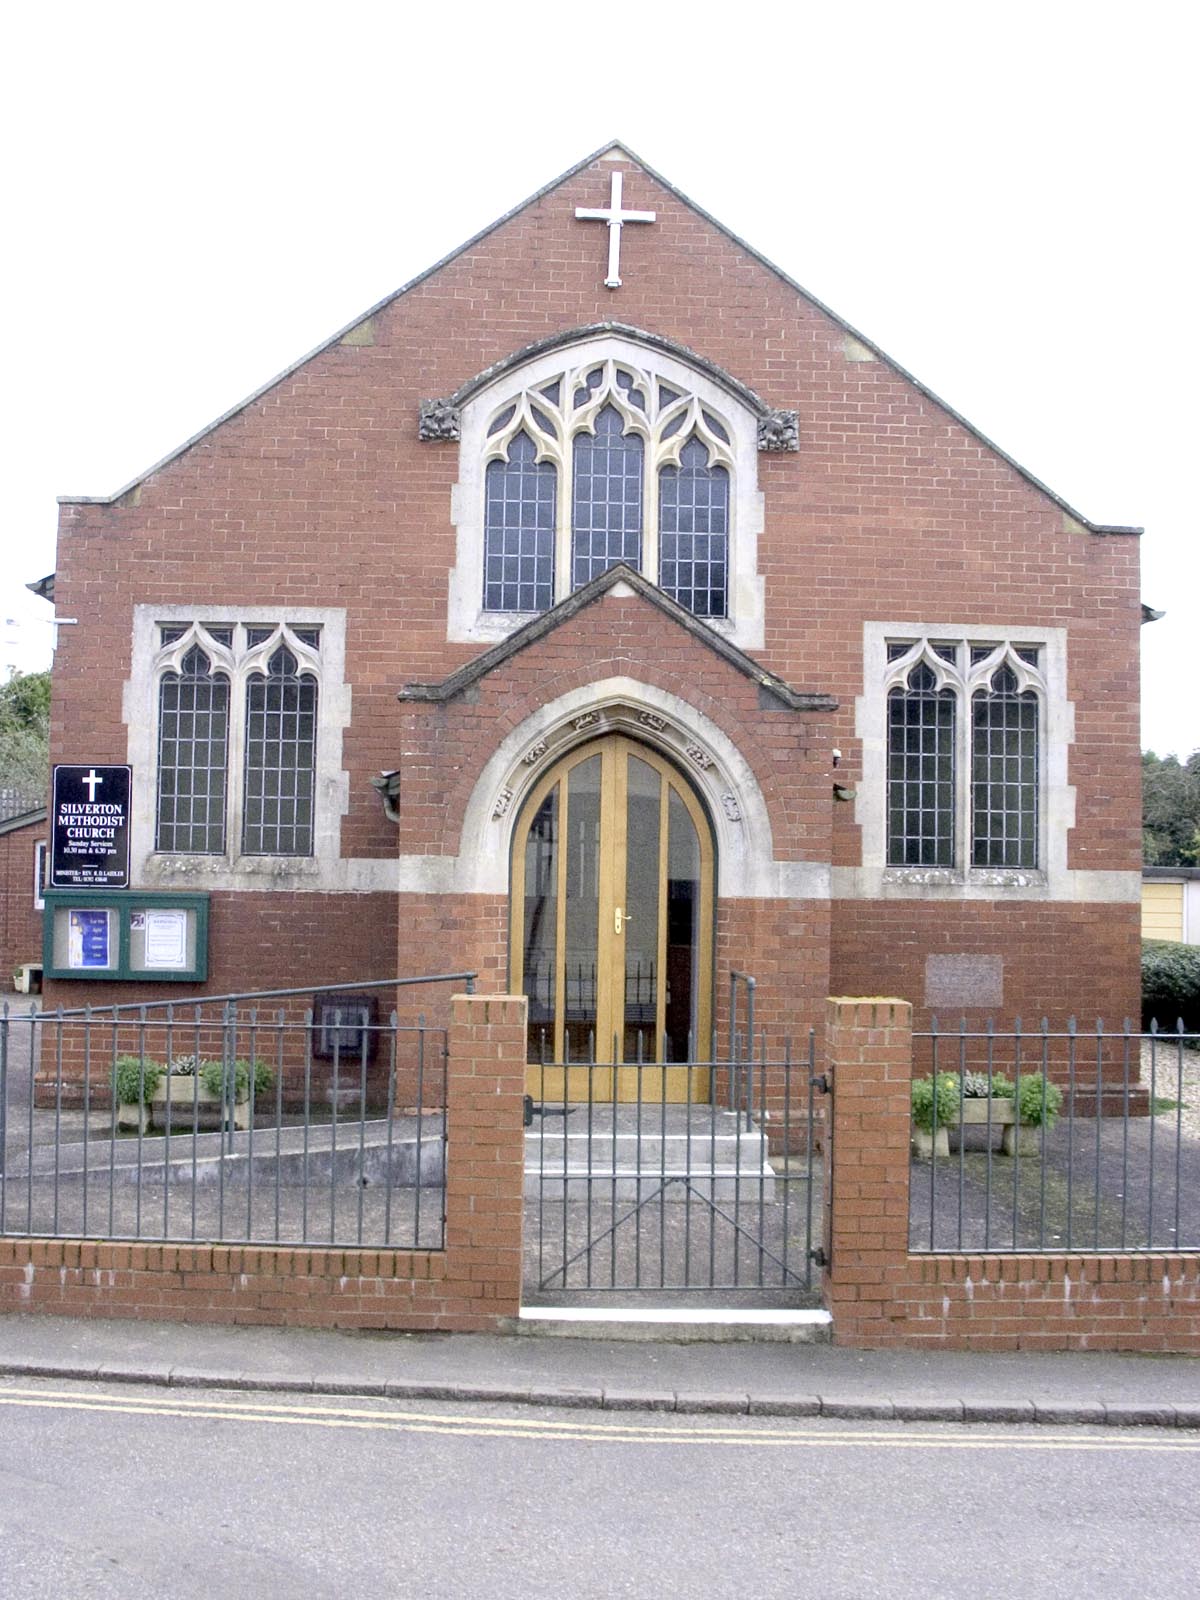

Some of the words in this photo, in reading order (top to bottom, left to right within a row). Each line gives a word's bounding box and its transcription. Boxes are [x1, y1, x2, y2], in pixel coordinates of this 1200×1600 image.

[60, 803, 122, 814] SILVERTON
[58, 815, 125, 826] METHODIST
[66, 827, 115, 838] CHURCH
